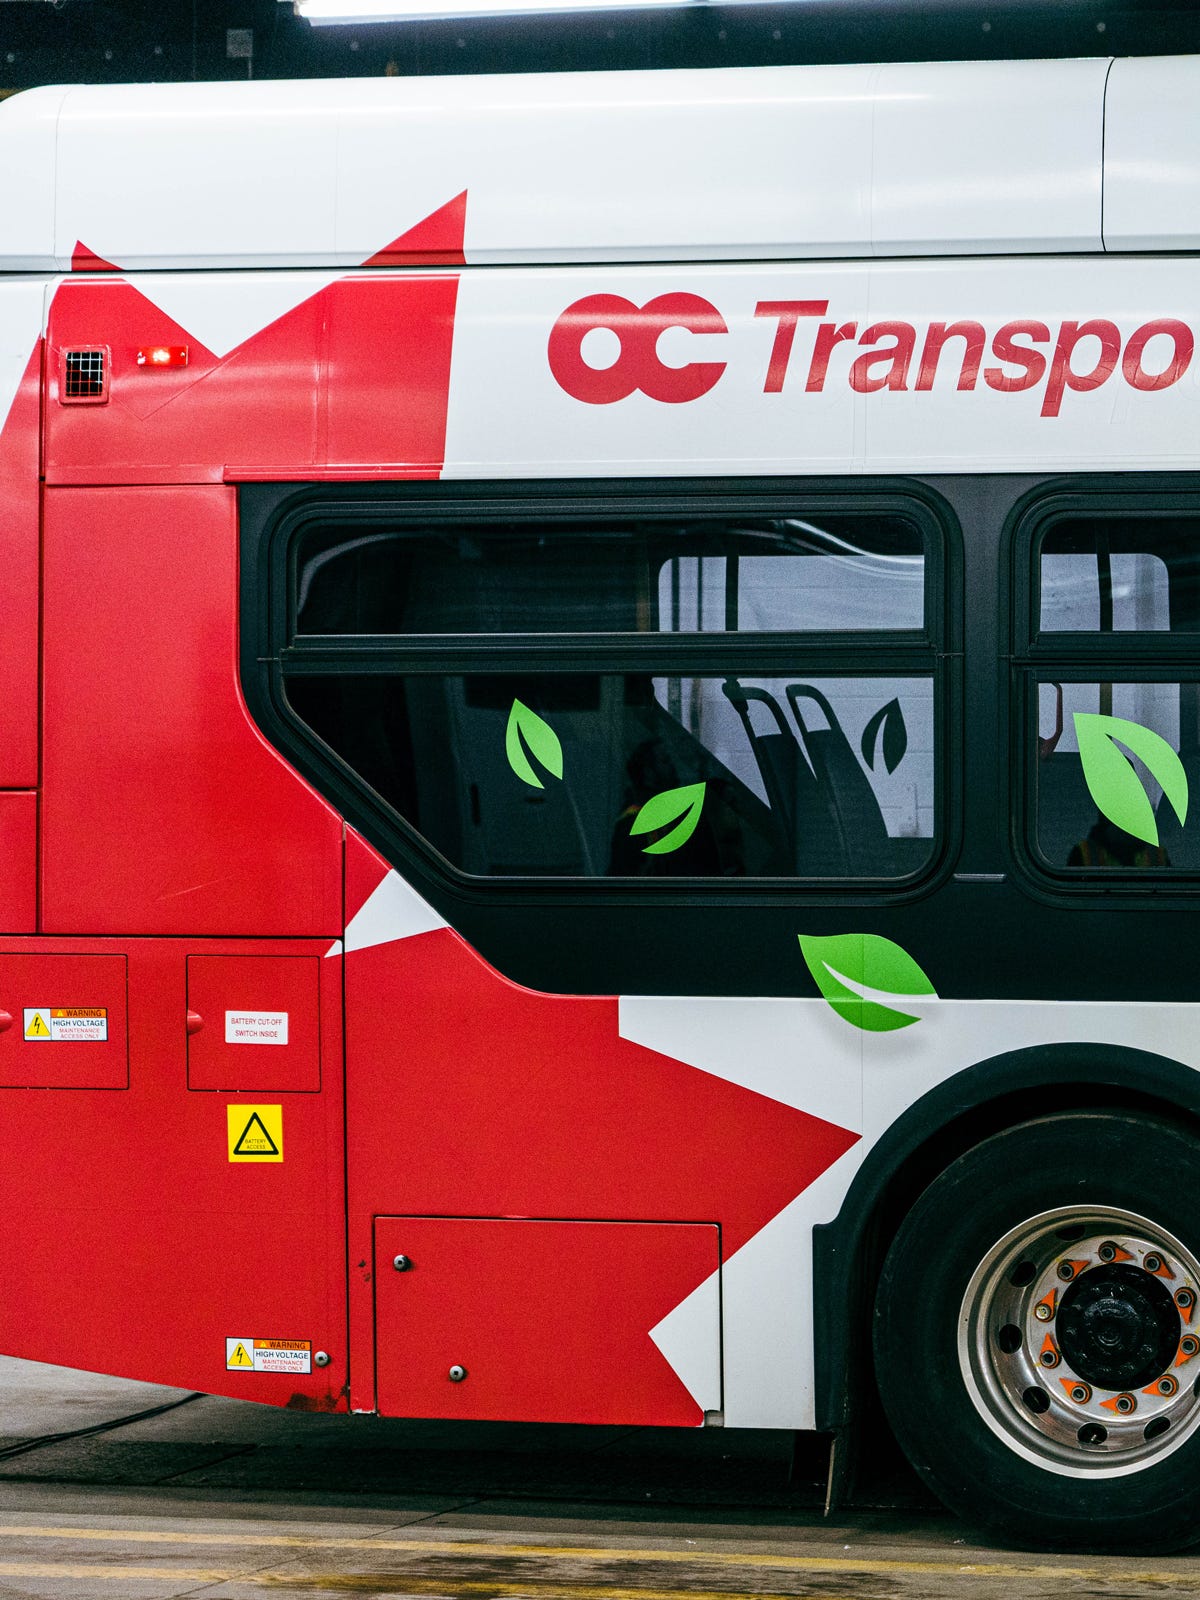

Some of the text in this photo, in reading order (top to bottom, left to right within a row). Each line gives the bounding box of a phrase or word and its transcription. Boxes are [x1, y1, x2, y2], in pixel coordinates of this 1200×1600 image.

[547, 291, 1194, 418] OC Transpo
[270, 1341, 306, 1350] WARNING
